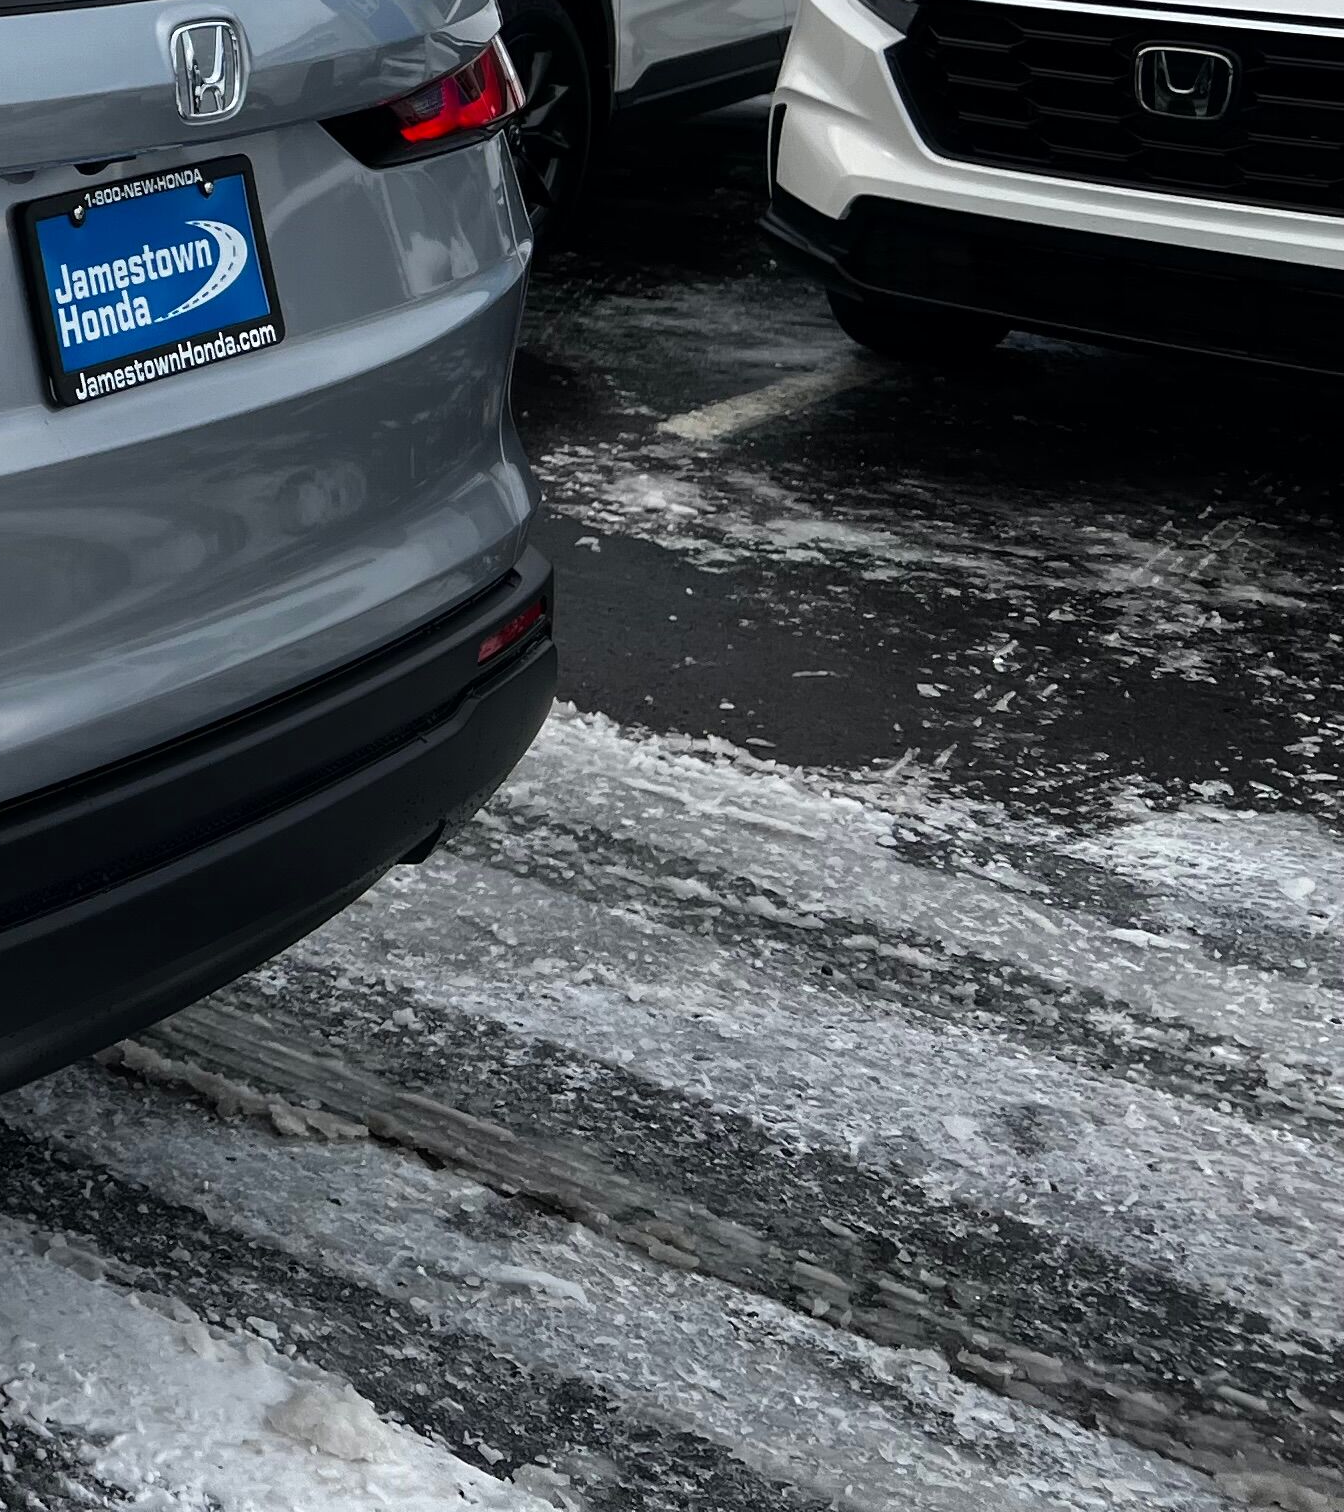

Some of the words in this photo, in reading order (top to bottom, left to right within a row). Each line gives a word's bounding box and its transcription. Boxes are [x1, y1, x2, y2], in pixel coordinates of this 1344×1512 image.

[55, 238, 213, 304] Jamestown
[58, 290, 151, 348] Honda
[75, 324, 277, 401] JamestownHonda.com
